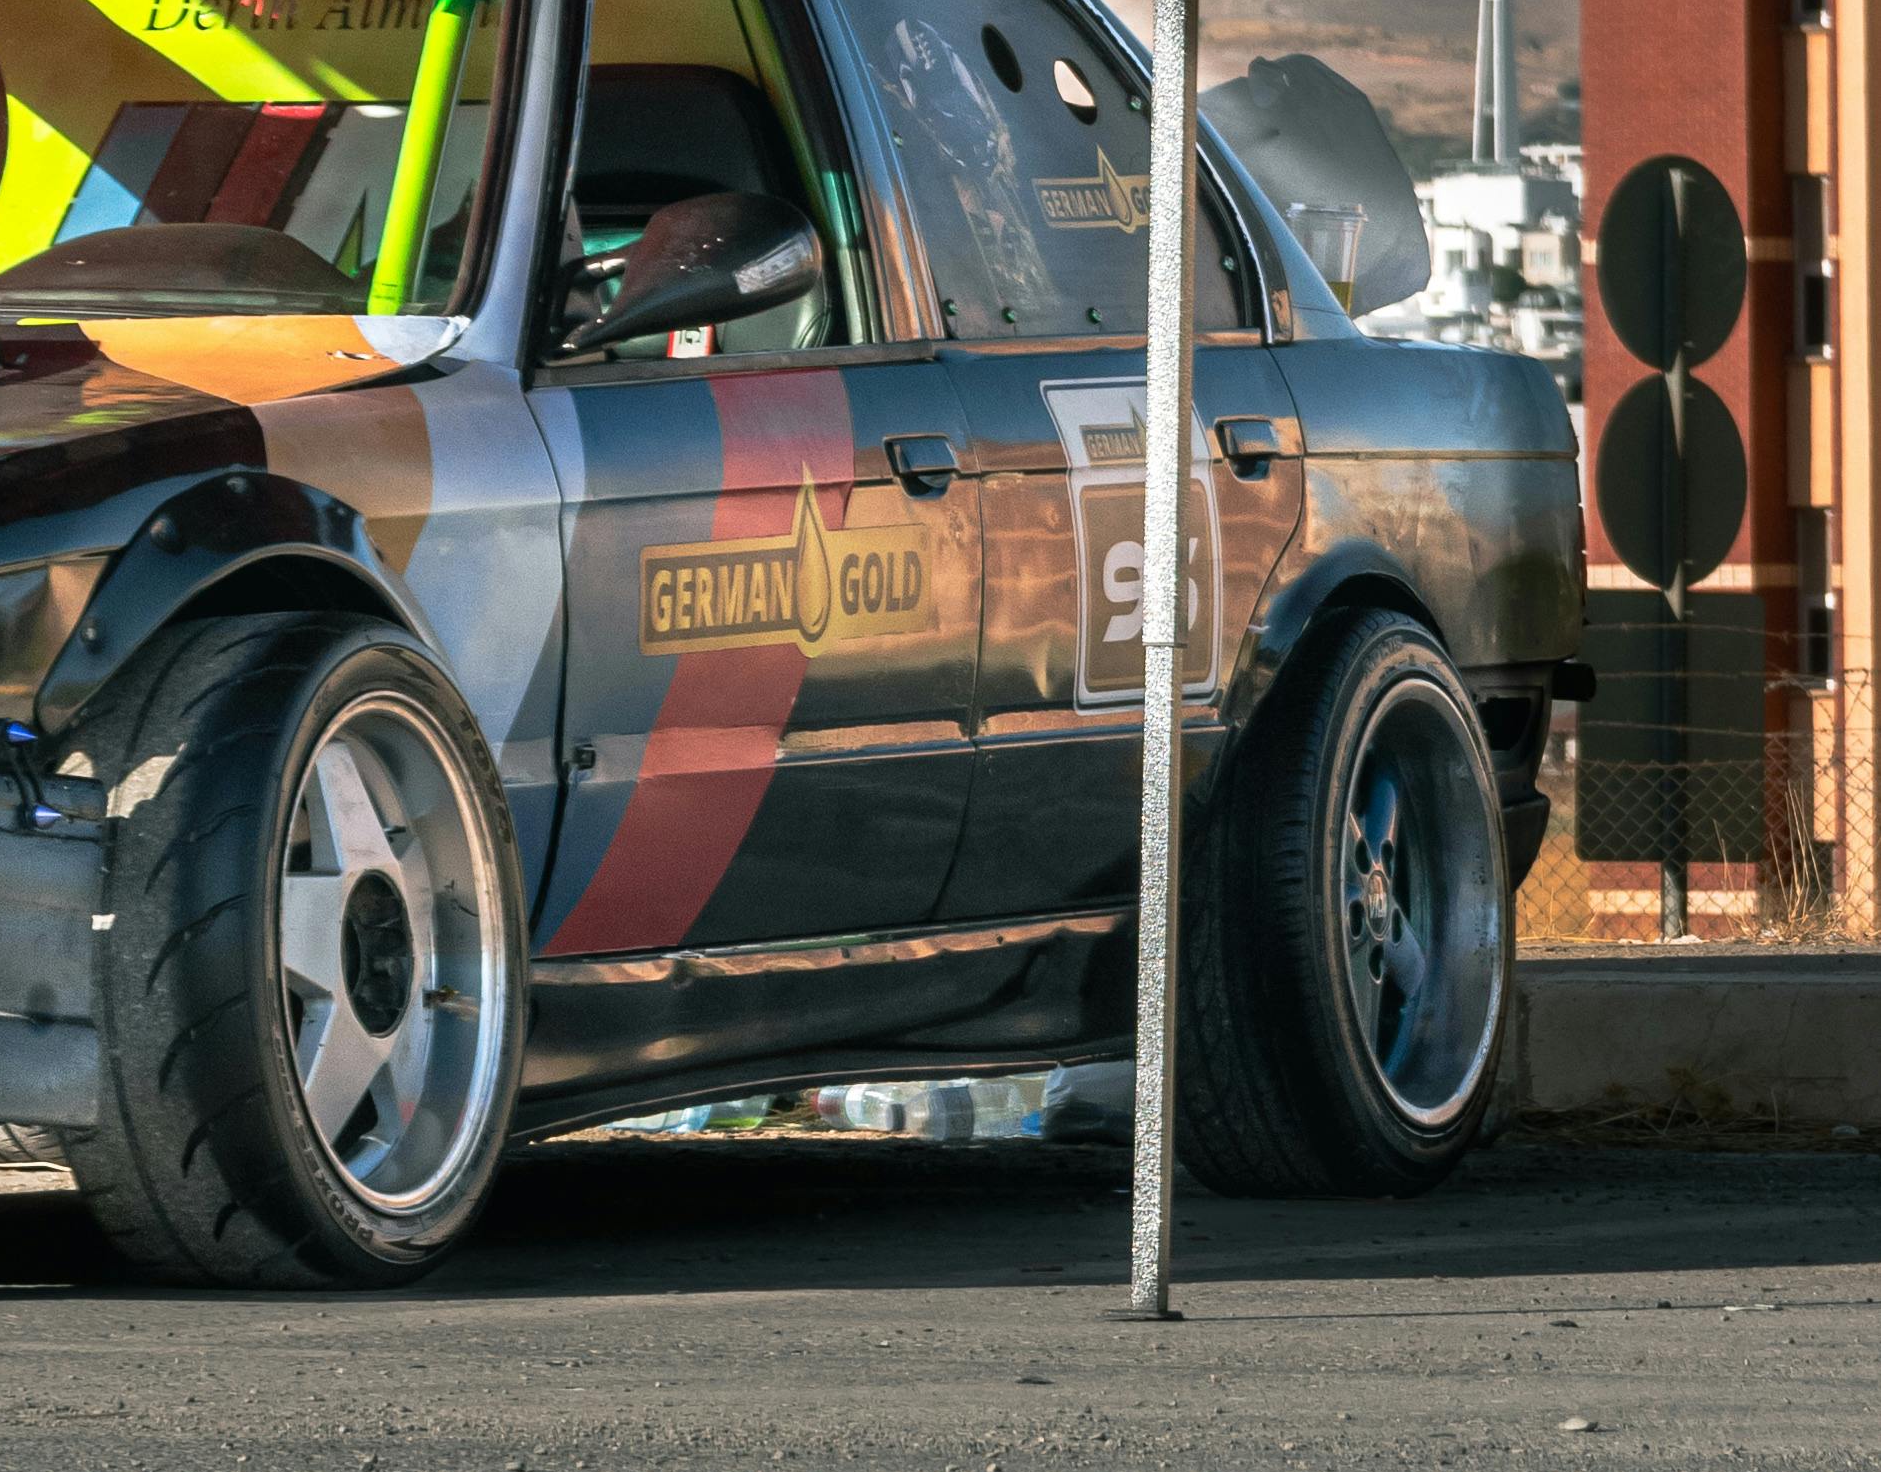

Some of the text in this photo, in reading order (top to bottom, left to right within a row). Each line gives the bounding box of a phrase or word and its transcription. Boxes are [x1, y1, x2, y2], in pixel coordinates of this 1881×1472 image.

[1040, 188, 1113, 218] GERMAN
[650, 550, 922, 633] GERMAN GOLD
[1102, 537, 1199, 642] 9
